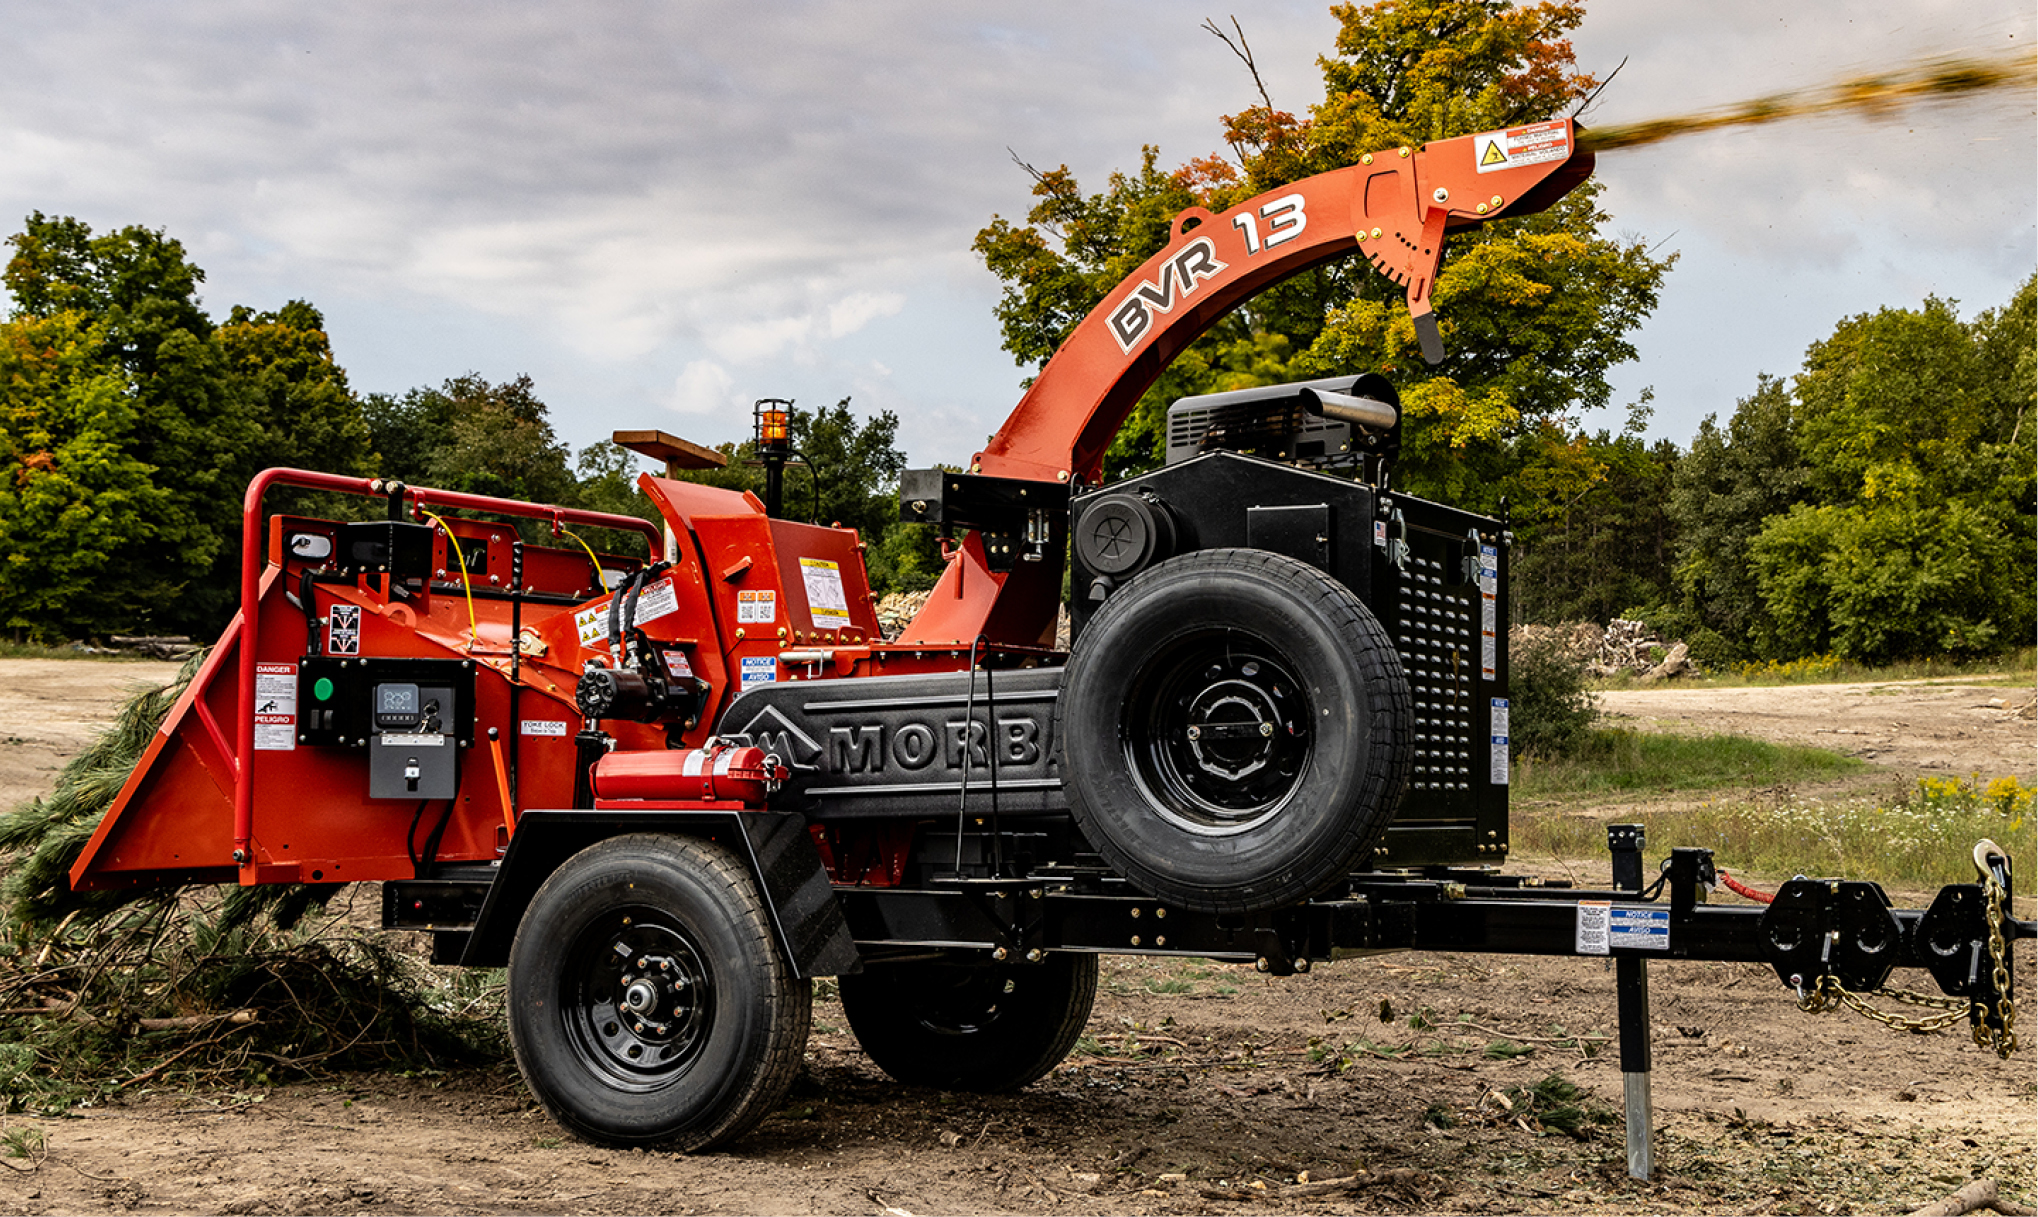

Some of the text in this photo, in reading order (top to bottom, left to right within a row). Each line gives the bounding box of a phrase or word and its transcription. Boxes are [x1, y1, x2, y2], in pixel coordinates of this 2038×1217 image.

[1106, 193, 1306, 353] BVR 13
[745, 657, 771, 666] NOTICE
[256, 665, 291, 673] DANGER
[255, 715, 290, 723] PELIGRO
[829, 717, 1058, 775] MORB
